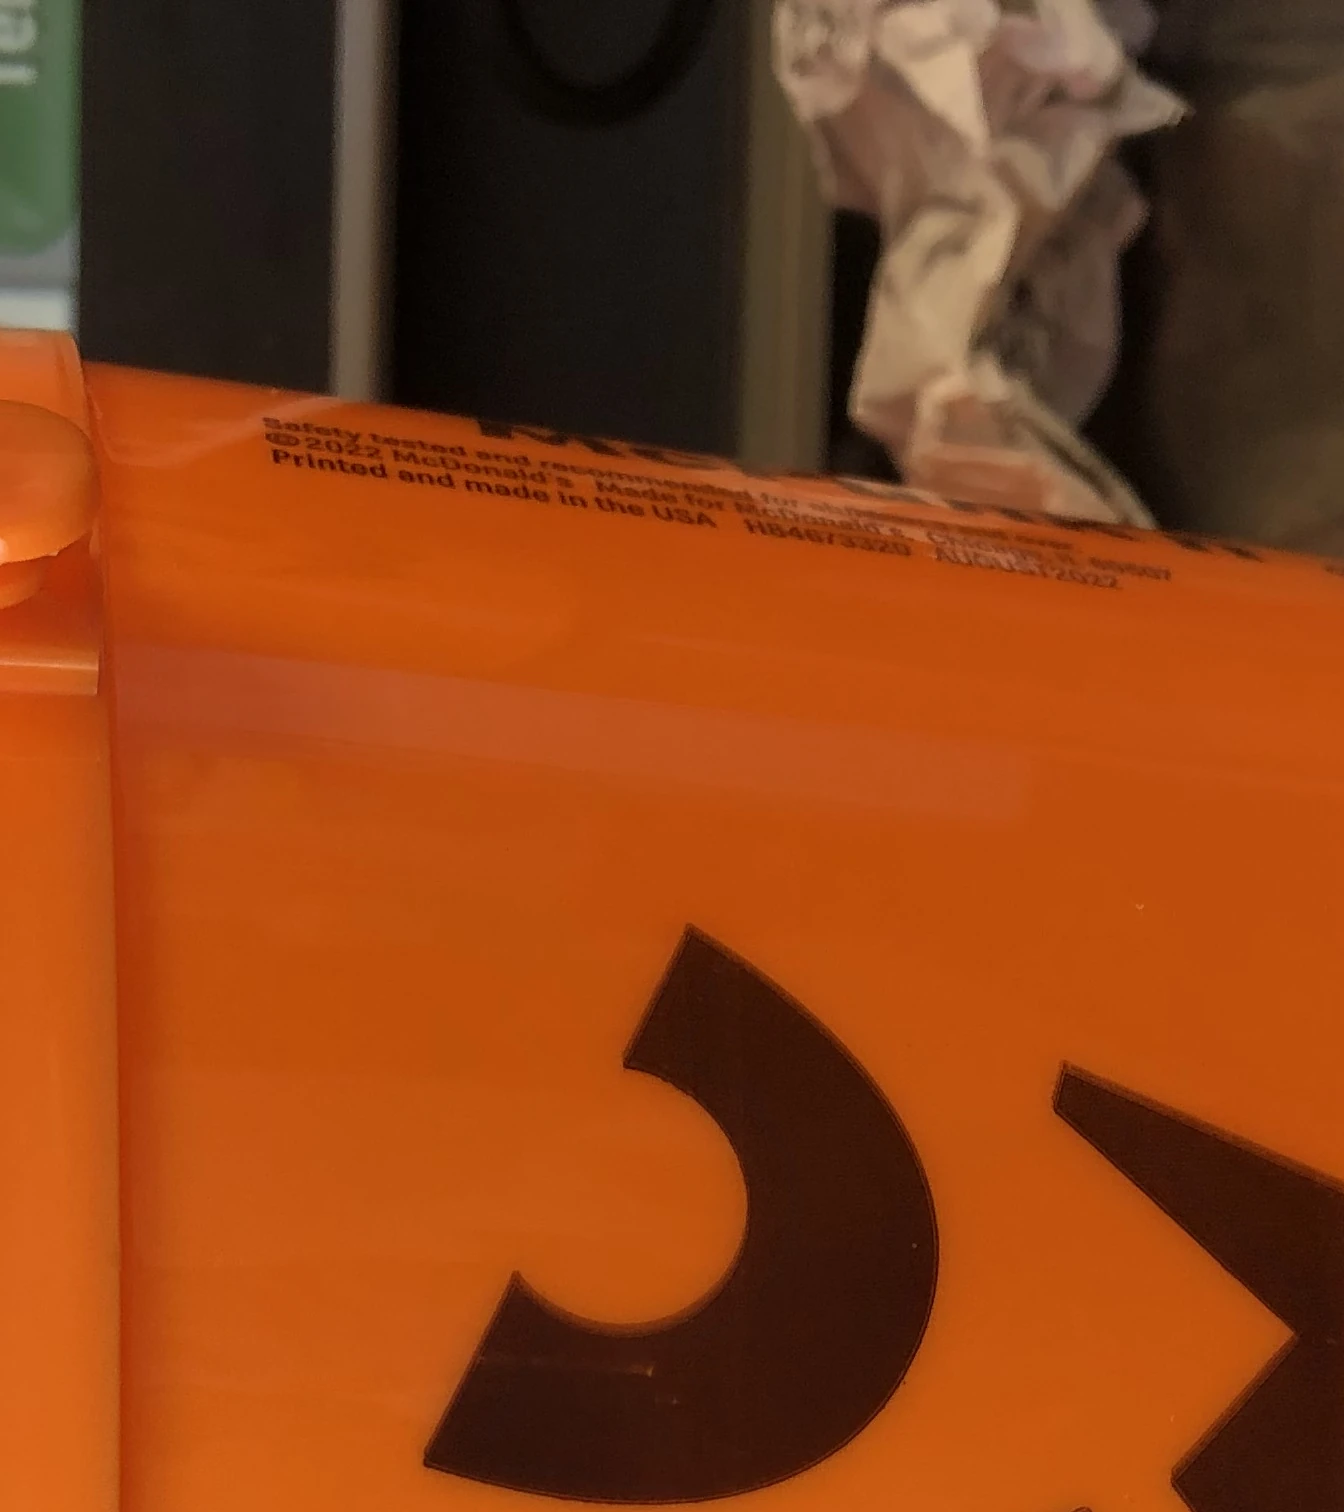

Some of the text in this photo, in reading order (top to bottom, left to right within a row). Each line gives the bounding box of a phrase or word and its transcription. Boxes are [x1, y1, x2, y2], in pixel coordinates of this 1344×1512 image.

[262, 416, 359, 443] Safety
[368, 432, 466, 457] tested
[475, 448, 530, 467] and
[272, 446, 386, 481] Printed
[398, 465, 455, 489] and
[464, 476, 549, 504] made
[557, 491, 588, 508] in
[594, 495, 644, 516] the
[651, 504, 717, 527] USA
